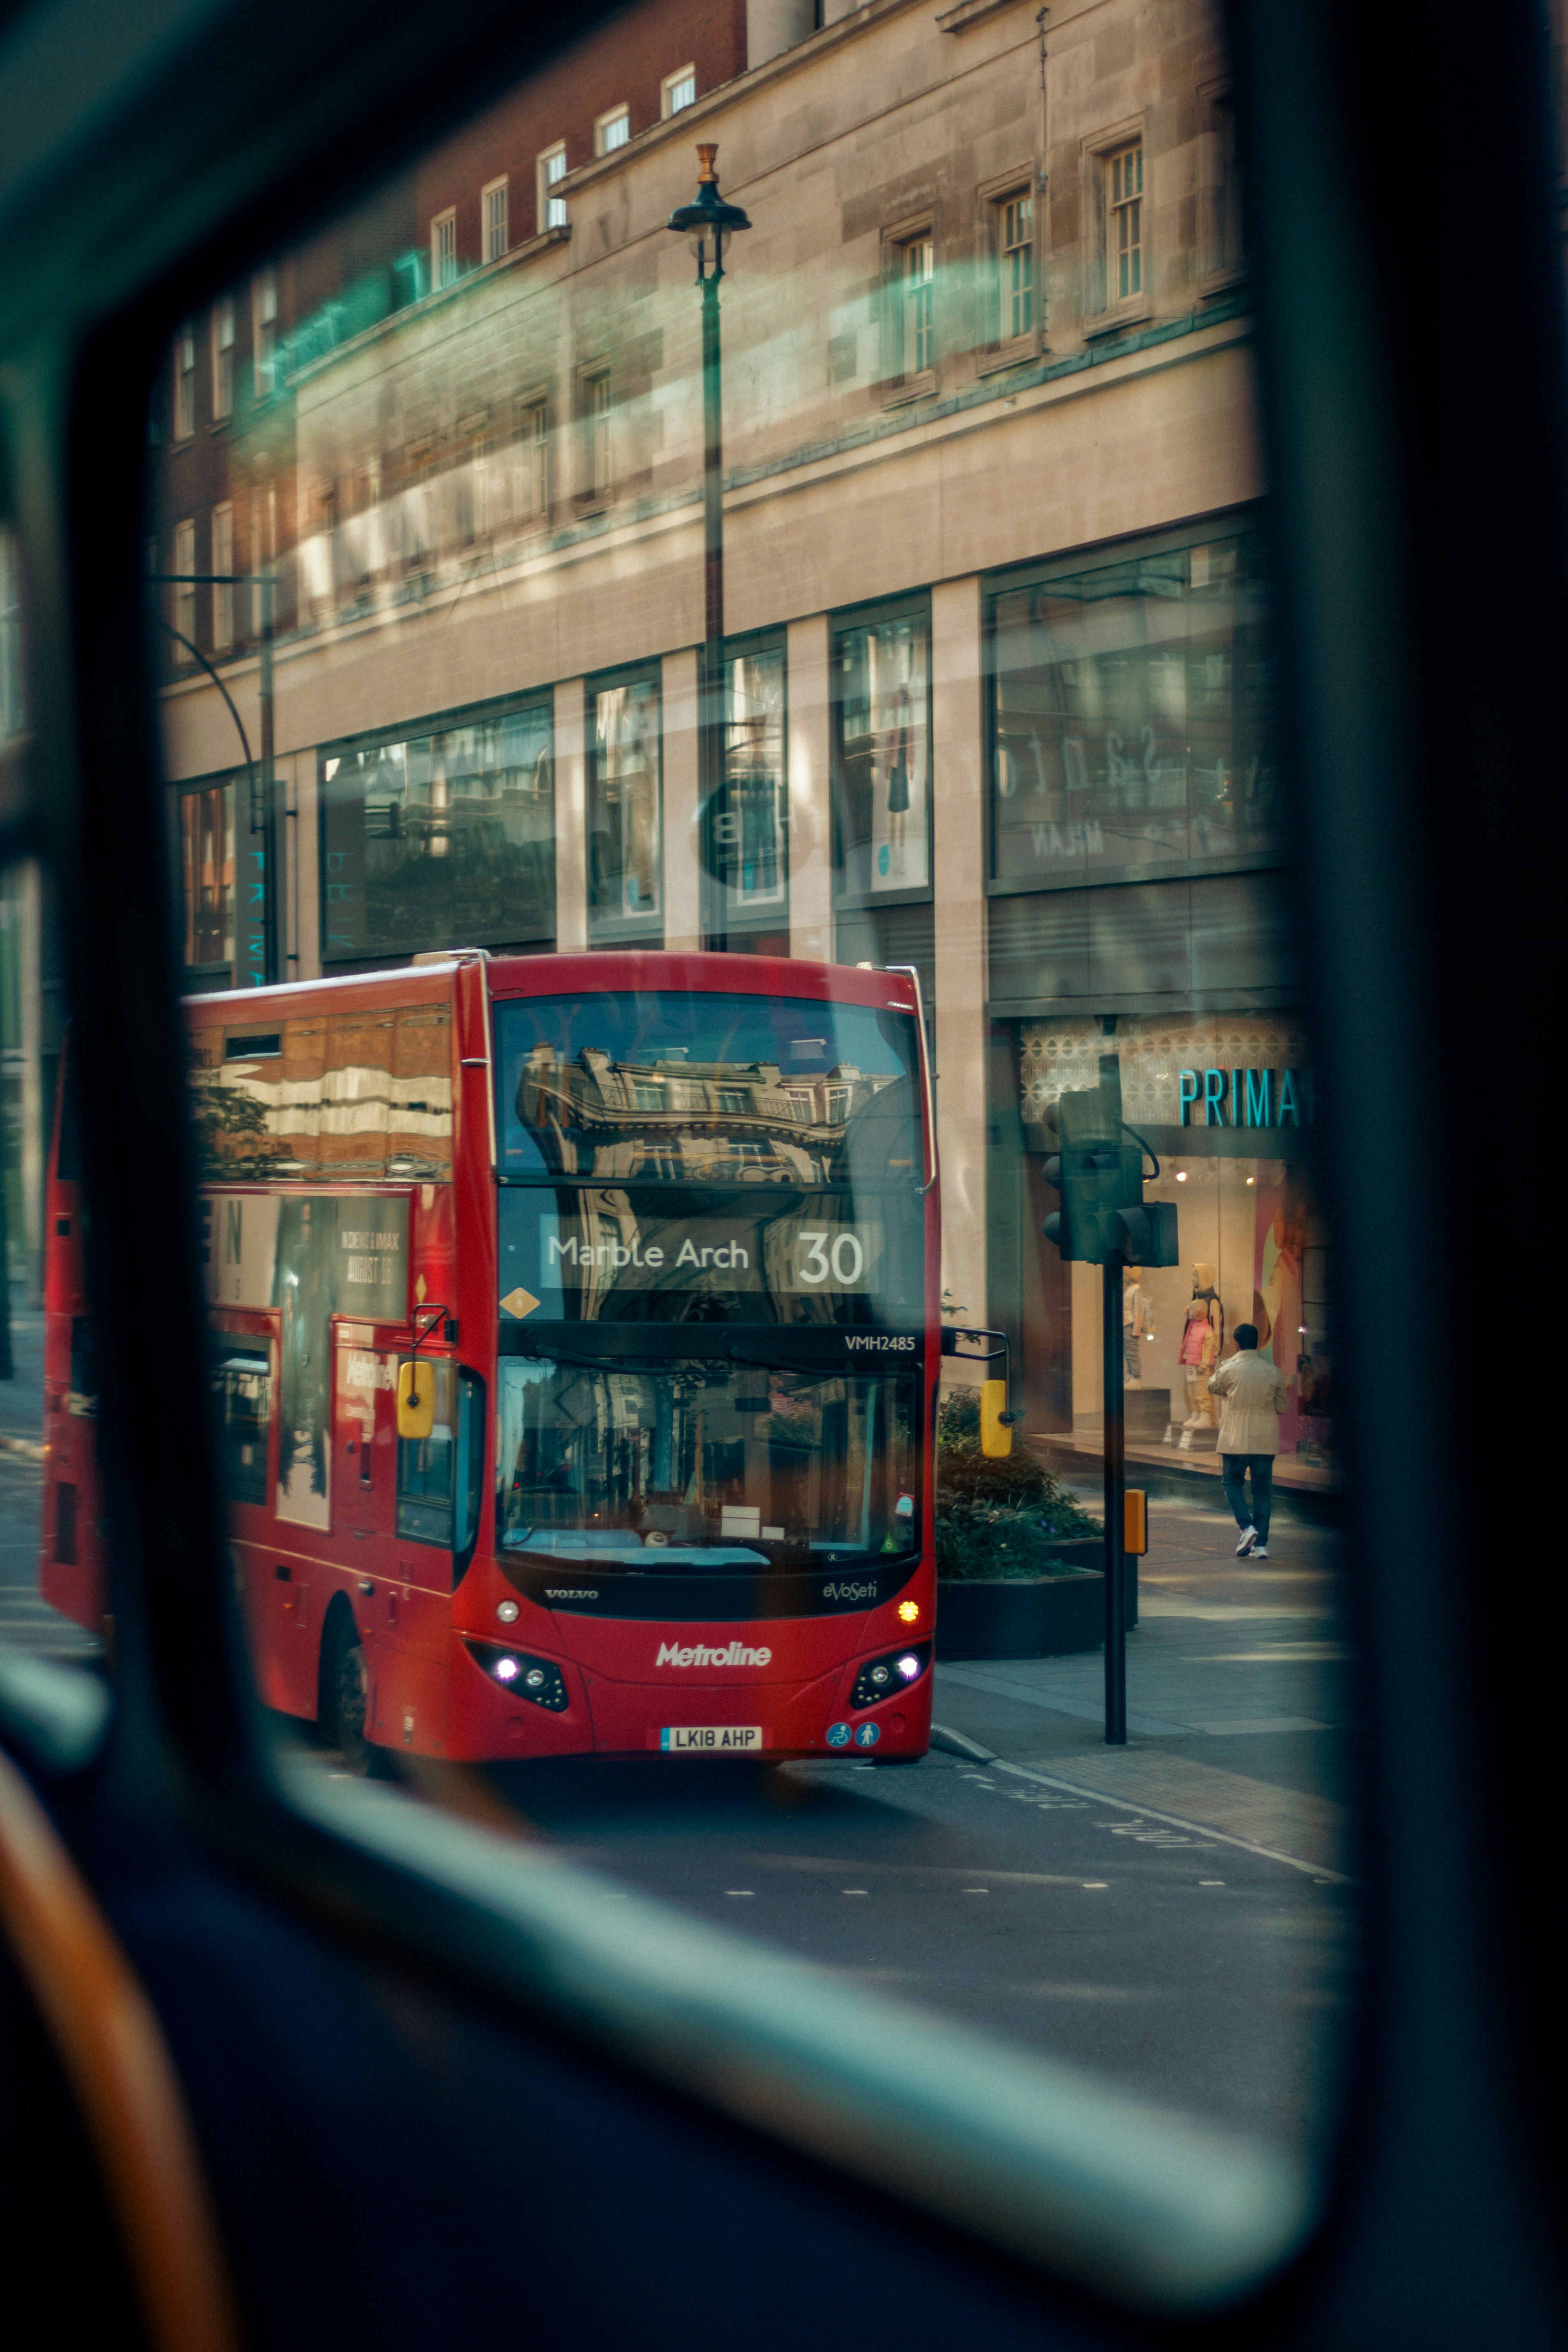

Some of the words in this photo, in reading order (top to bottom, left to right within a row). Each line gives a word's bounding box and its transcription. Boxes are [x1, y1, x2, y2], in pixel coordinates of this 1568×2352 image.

[376, 1232, 400, 1250] IMAX
[548, 1236, 664, 1268] Marble
[676, 1239, 748, 1268] Arch
[799, 1231, 862, 1285] 30
[845, 1336, 915, 1351] VMH2485
[885, 1539, 893, 1549] 6
[545, 1589, 599, 1599] VOLVO
[656, 1642, 771, 1667] Metroline
[676, 1730, 715, 1747] LK18
[721, 1730, 755, 1747] AHP
